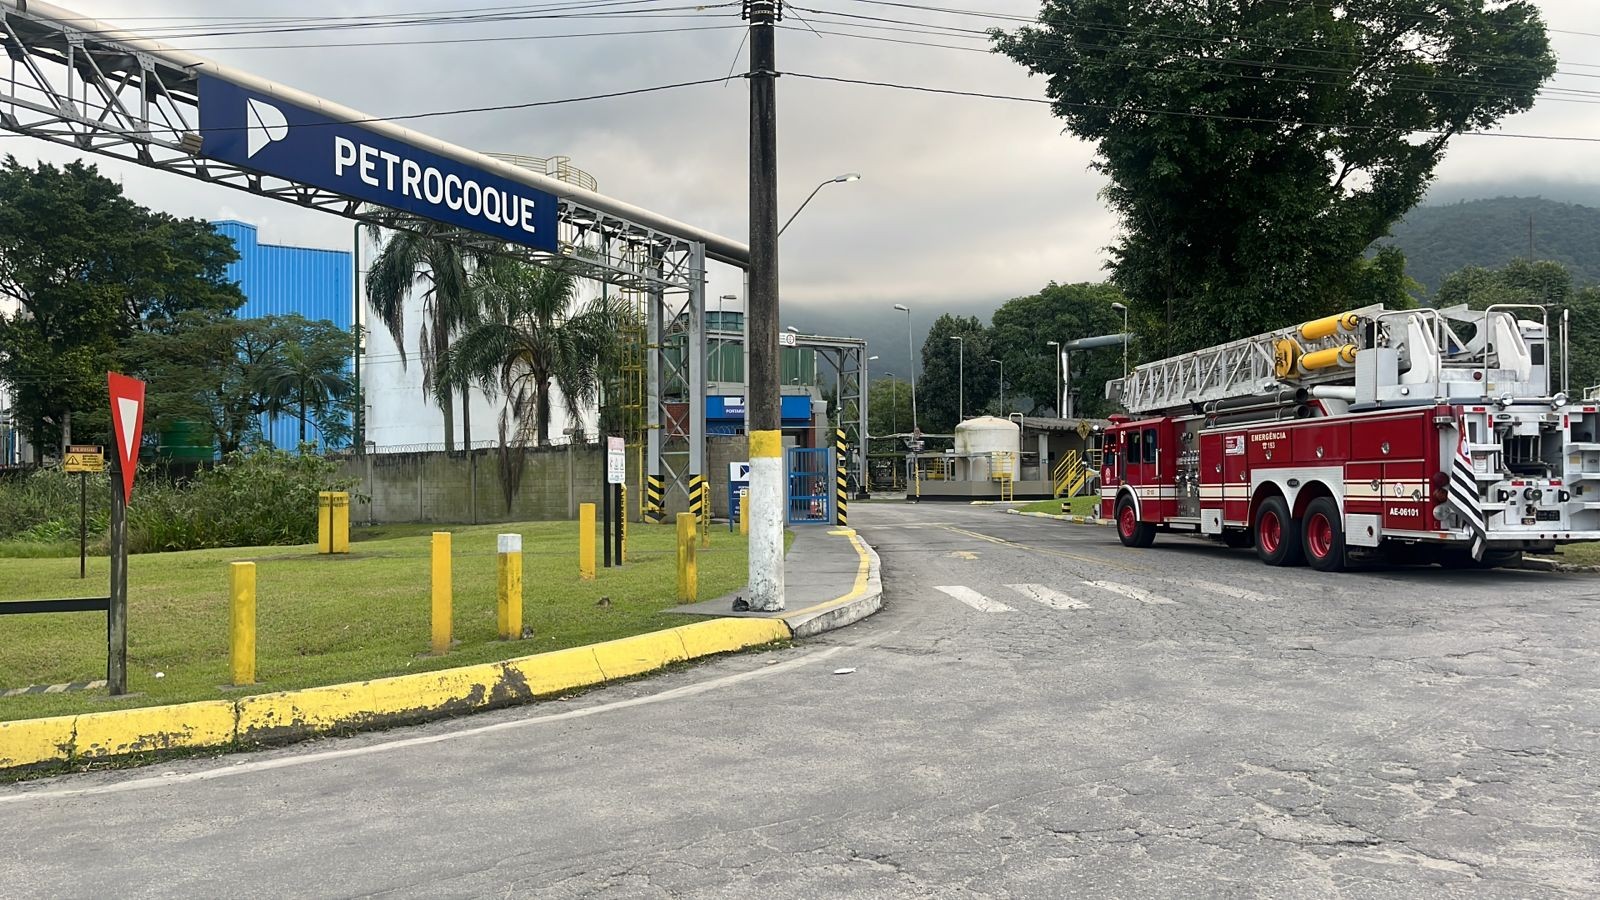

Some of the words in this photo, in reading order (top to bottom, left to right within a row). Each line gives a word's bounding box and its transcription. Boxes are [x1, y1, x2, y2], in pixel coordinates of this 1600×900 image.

[334, 135, 535, 233] PETROCOQUE
[1251, 432, 1287, 442] EMERGÊNCIA
[1389, 507, 1419, 517] AE-06101
